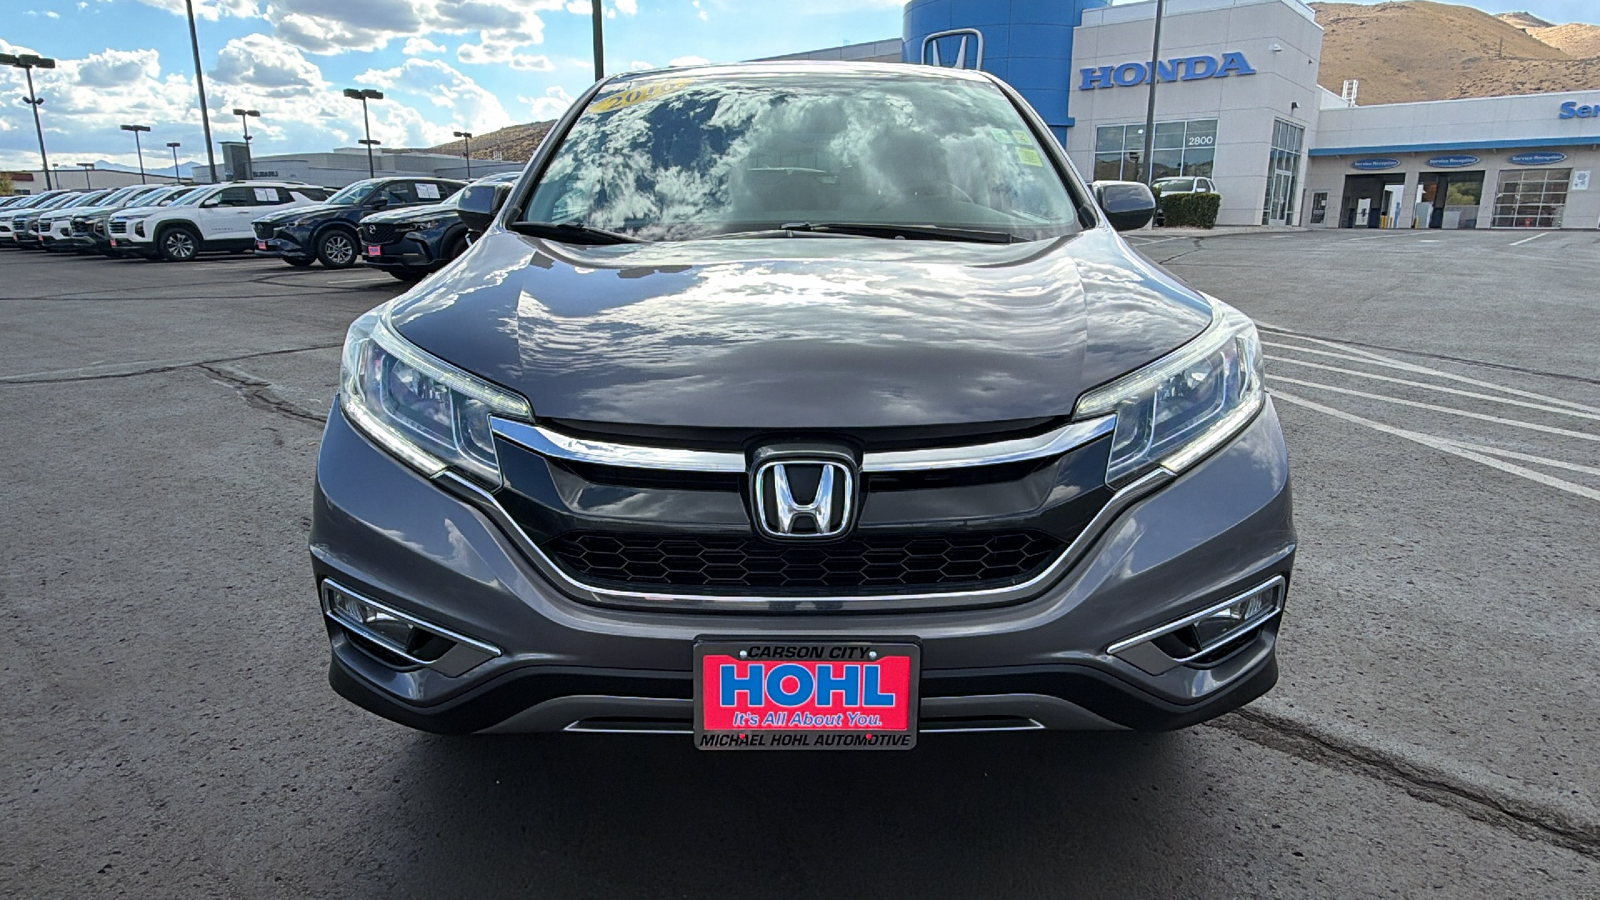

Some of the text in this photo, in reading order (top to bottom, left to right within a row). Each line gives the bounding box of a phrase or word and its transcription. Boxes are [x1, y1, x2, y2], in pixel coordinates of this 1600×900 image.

[1079, 52, 1256, 90] HONDA
[1188, 136, 1213, 146] 2800
[747, 646, 871, 659] CARSON CITY
[719, 663, 896, 707] HOHL
[732, 711, 882, 727] It's All About You.
[700, 733, 912, 747] MICHAEL HOHL AUTOMOTIVE
